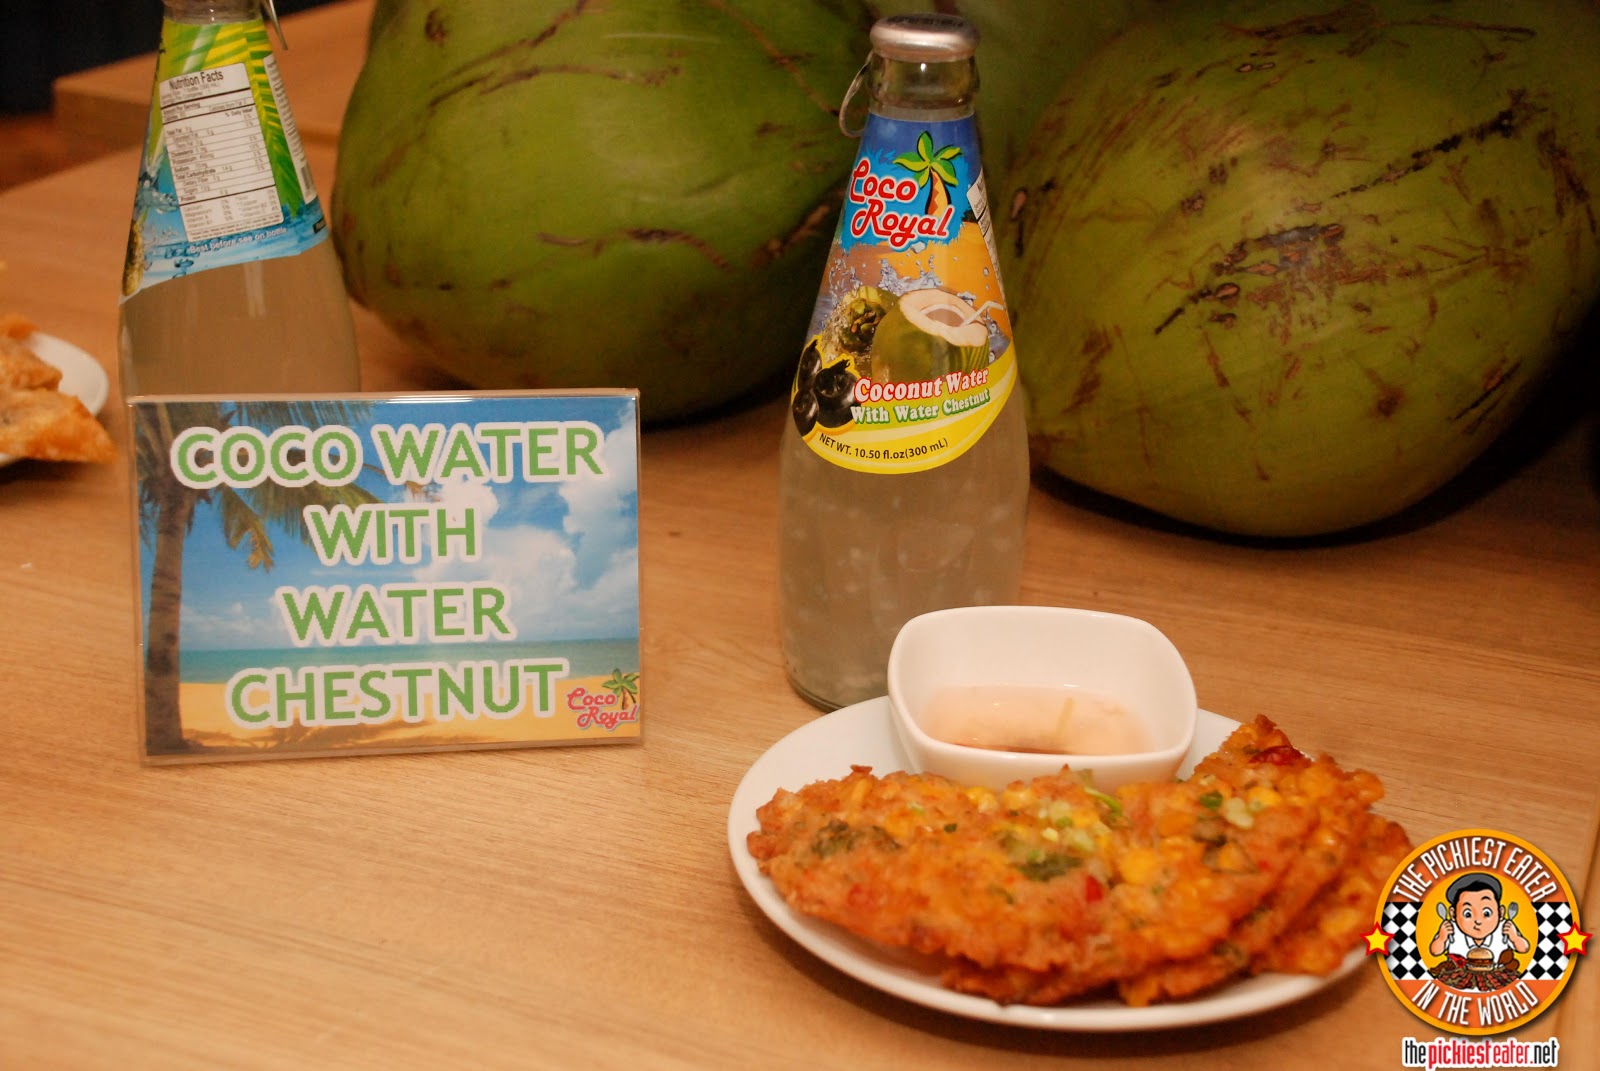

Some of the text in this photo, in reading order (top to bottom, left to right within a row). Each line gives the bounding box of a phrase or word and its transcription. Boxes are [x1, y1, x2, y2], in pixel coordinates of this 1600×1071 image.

[169, 76, 200, 90] Nutrition
[200, 70, 224, 83] Facts
[849, 159, 917, 203] Coco
[210, 238, 236, 249] before
[266, 226, 287, 237] bottle
[851, 199, 953, 247] Royal
[854, 368, 988, 403] Coconut Water
[851, 389, 990, 424] With Water Chestnut
[177, 426, 604, 484] COCO WATER
[819, 433, 835, 448] NET
[836, 442, 852, 455] WT.
[855, 448, 880, 459] 10.50
[930, 438, 948, 452] mL)
[310, 507, 476, 560] WITH
[282, 586, 512, 641] WATER
[230, 663, 564, 723] CHESTNUT
[567, 688, 616, 710] Coco
[577, 705, 637, 729] Royal
